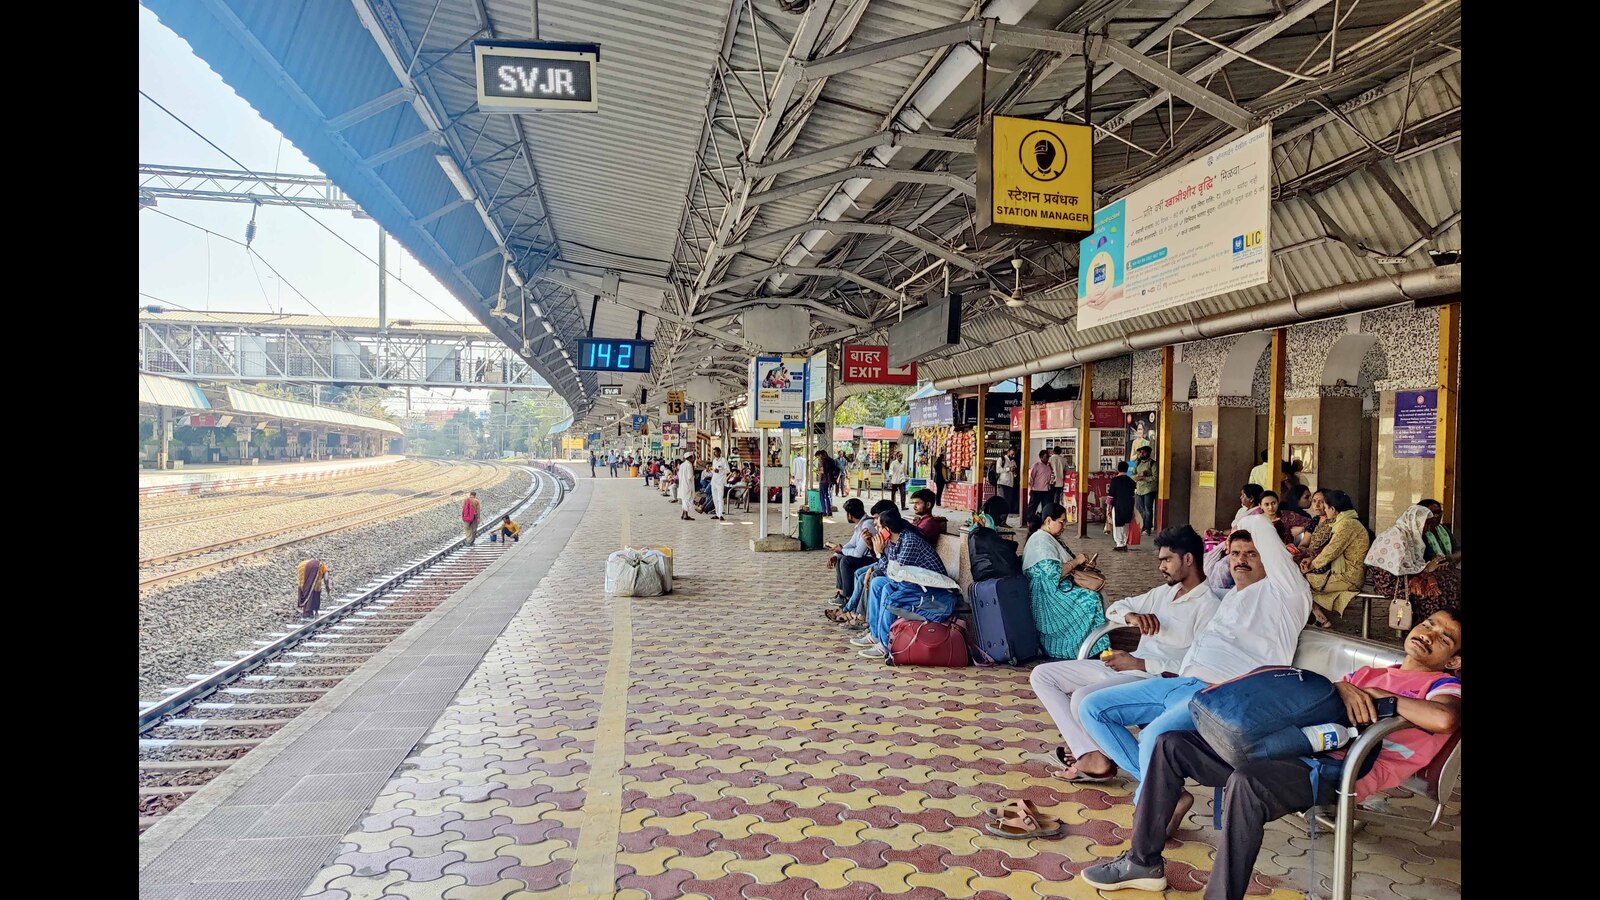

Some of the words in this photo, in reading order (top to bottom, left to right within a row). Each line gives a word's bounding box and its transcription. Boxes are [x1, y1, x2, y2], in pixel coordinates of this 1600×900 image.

[498, 65, 576, 95] SVJR
[1164, 186, 1197, 208] खात्रीशीर
[1220, 165, 1240, 182] मिळवा
[1007, 186, 1041, 203] स्टेशन
[1043, 192, 1079, 206] प्रबंधक
[996, 206, 1038, 217] STATION
[1040, 210, 1090, 223] MANAGER
[1245, 230, 1261, 248] LIC
[850, 350, 881, 364] बाहर
[849, 366, 881, 378] EXIT
[668, 402, 682, 414] 13
